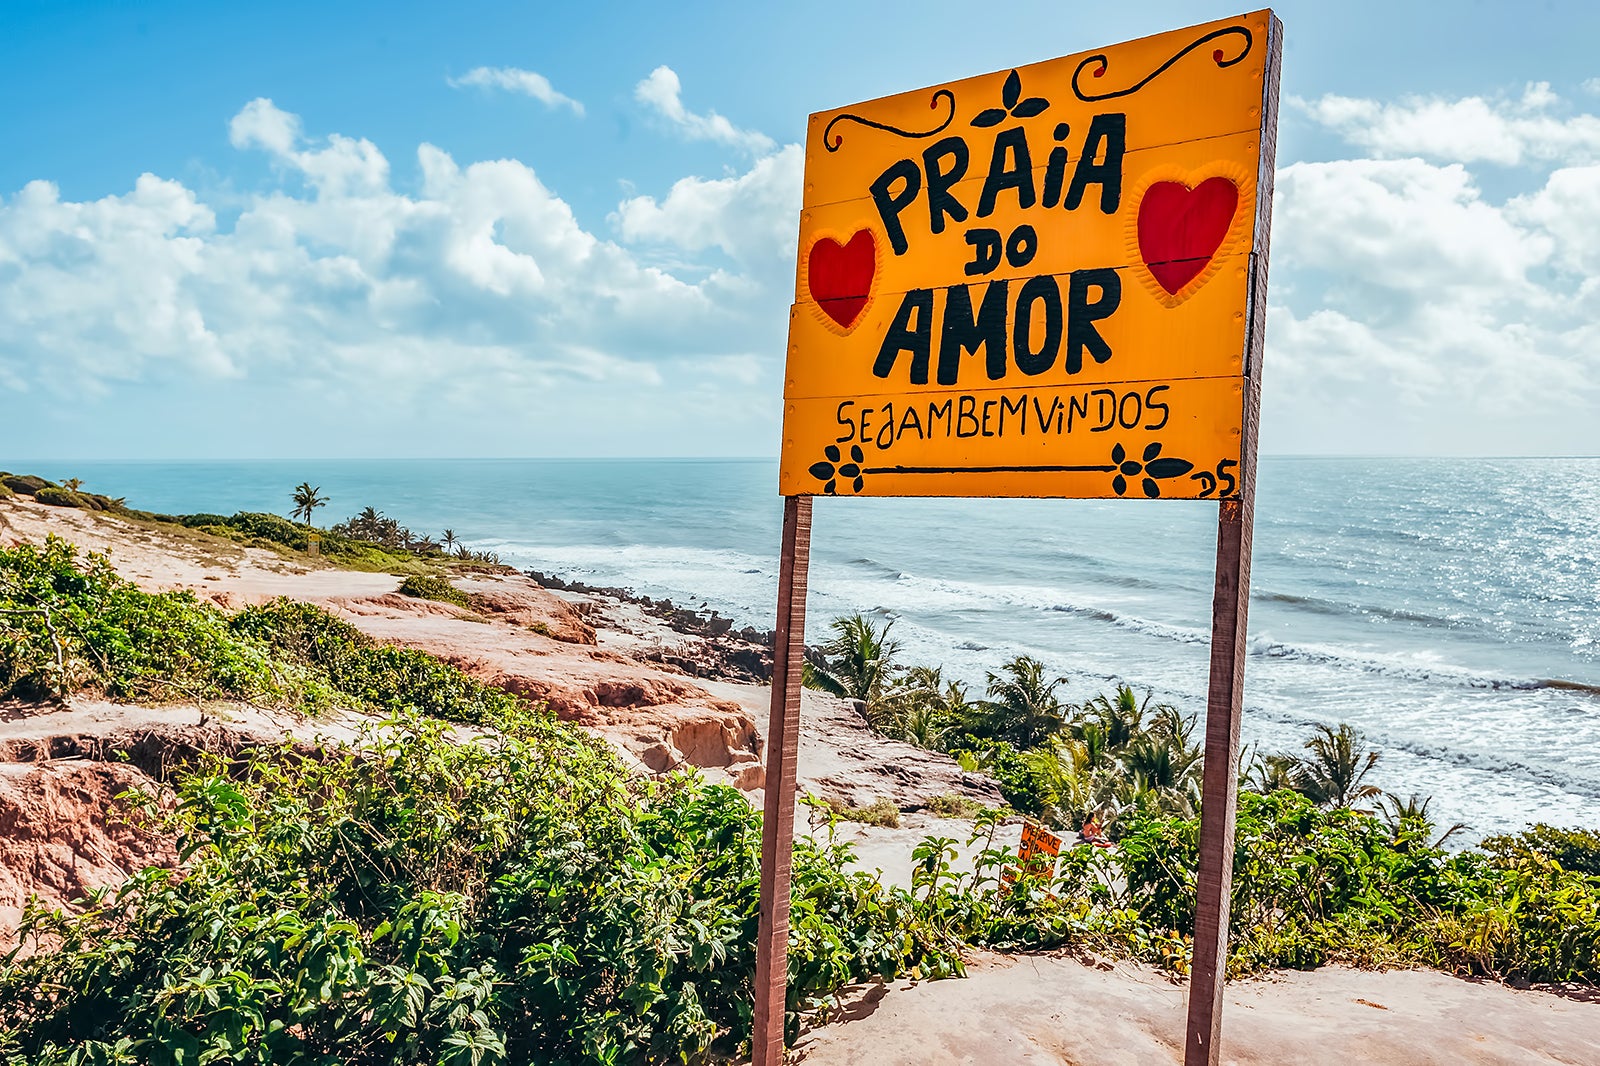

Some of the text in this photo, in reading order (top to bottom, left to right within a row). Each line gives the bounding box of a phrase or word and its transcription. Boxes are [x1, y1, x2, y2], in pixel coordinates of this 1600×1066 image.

[964, 224, 1038, 276] DO
[872, 266, 1128, 386] AMOR
[1190, 458, 1238, 497] DS
